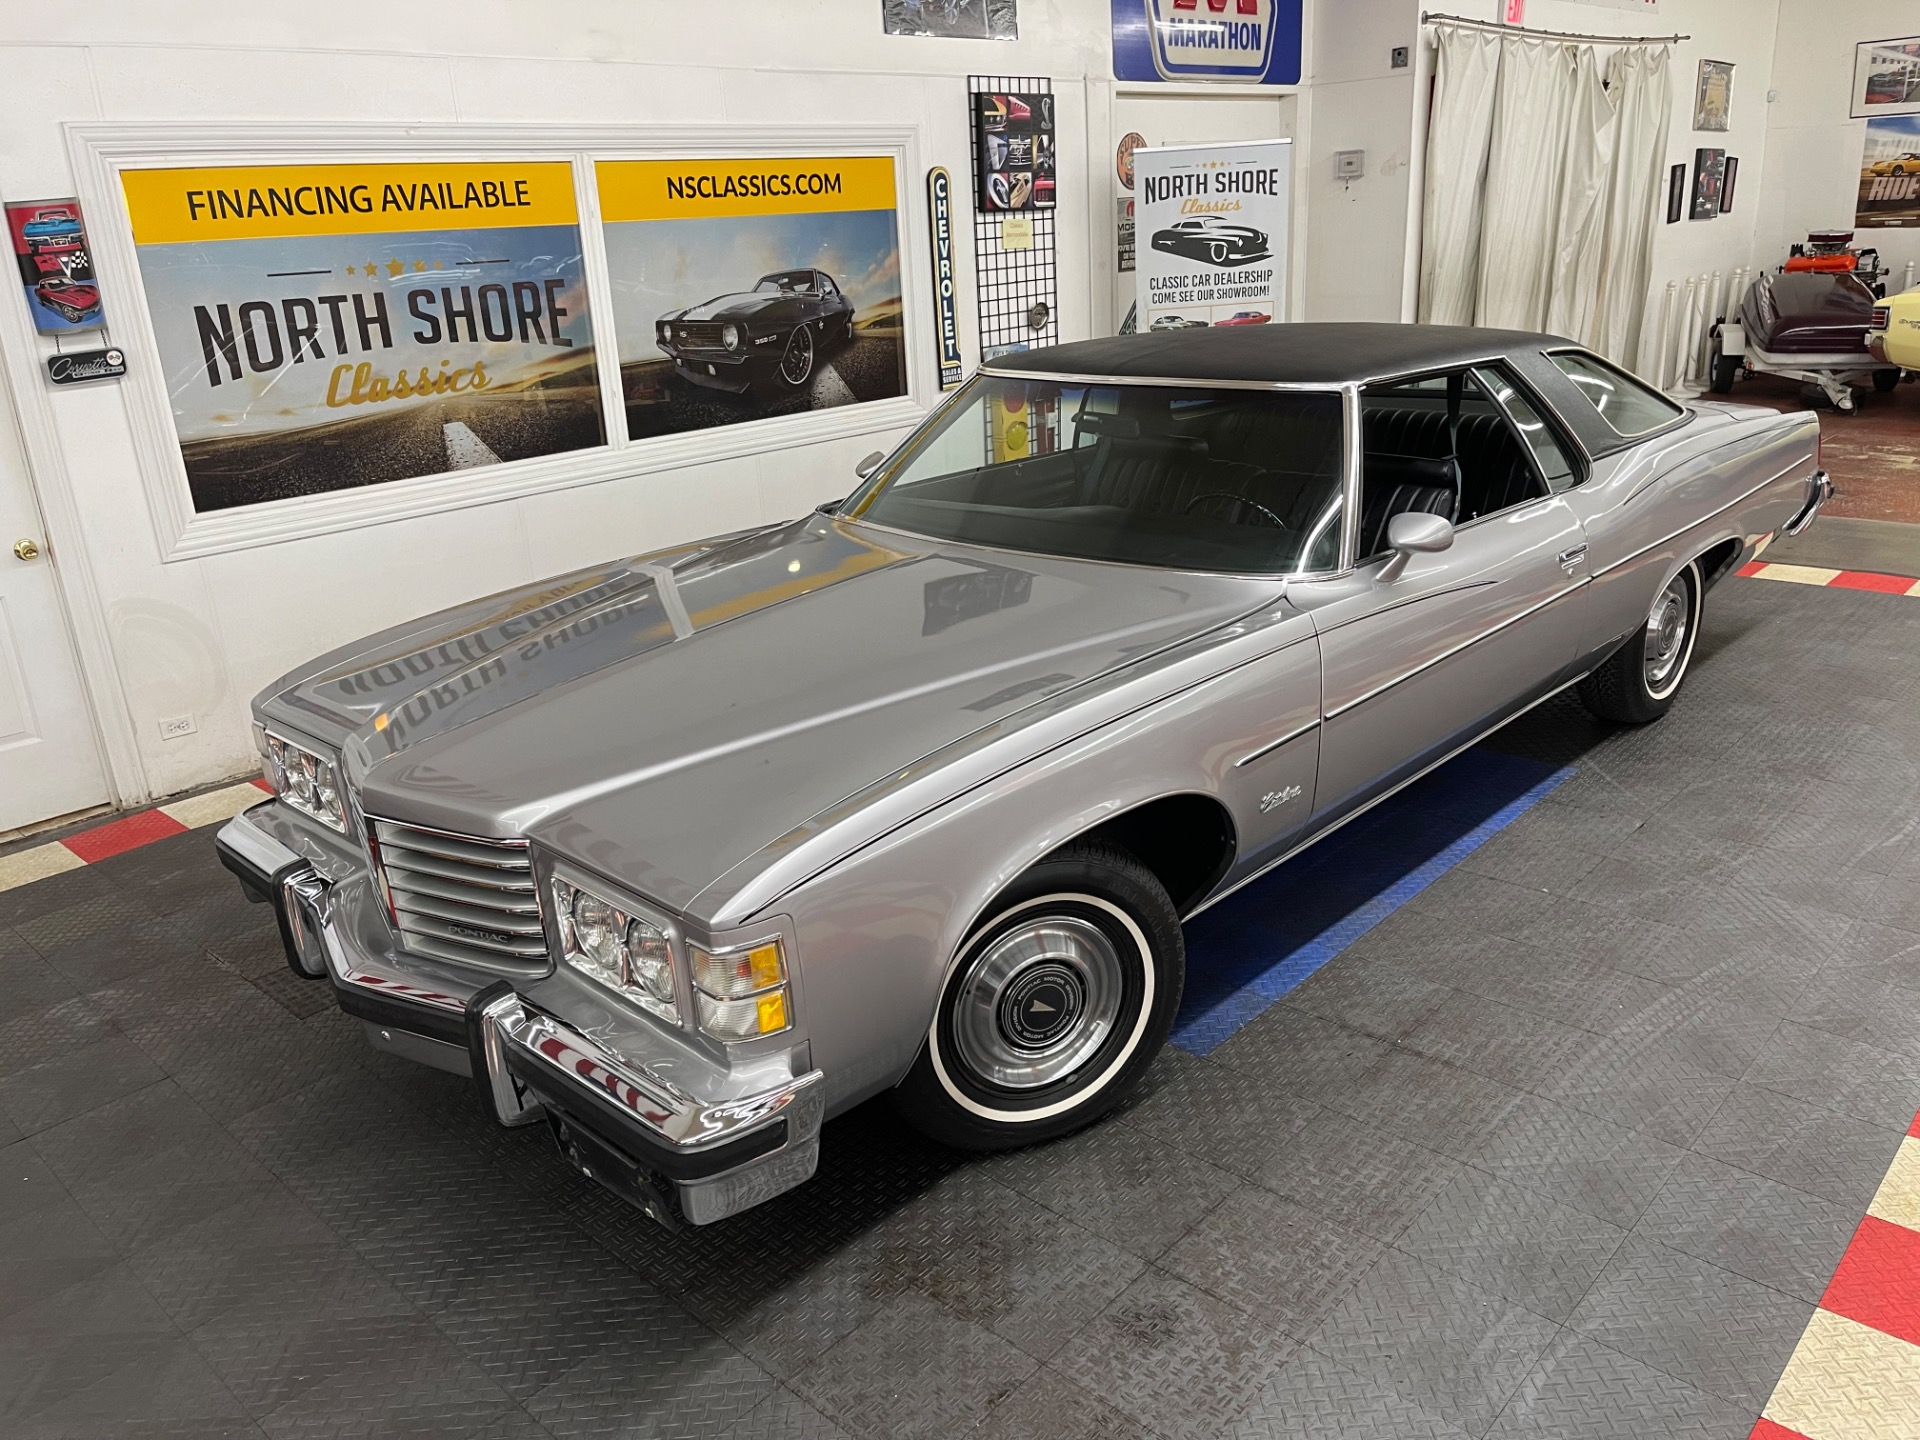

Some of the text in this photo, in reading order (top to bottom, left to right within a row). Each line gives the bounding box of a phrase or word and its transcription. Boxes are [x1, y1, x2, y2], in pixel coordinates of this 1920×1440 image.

[1168, 17, 1262, 51] MARATHON
[666, 173, 842, 199] NSCLASSICS.COM
[1145, 169, 1278, 205] NORTH SHORE
[186, 180, 531, 221] FINANCING AVAILABLE
[1181, 198, 1242, 214] Classics
[935, 178, 955, 357] CHEVROLET
[1150, 269, 1273, 290] CLASSIC CAR DEALERSHIP
[1152, 285, 1270, 304] COME SEE OUR SHOWROOM!
[193, 278, 573, 388] NORTH SHORE
[51, 357, 109, 380] Corvette
[326, 359, 493, 408] Classics
[447, 925, 508, 943] PONTIAC
[1018, 979, 1041, 1000] PONTIAC
[1044, 976, 1064, 985] MOTOR
